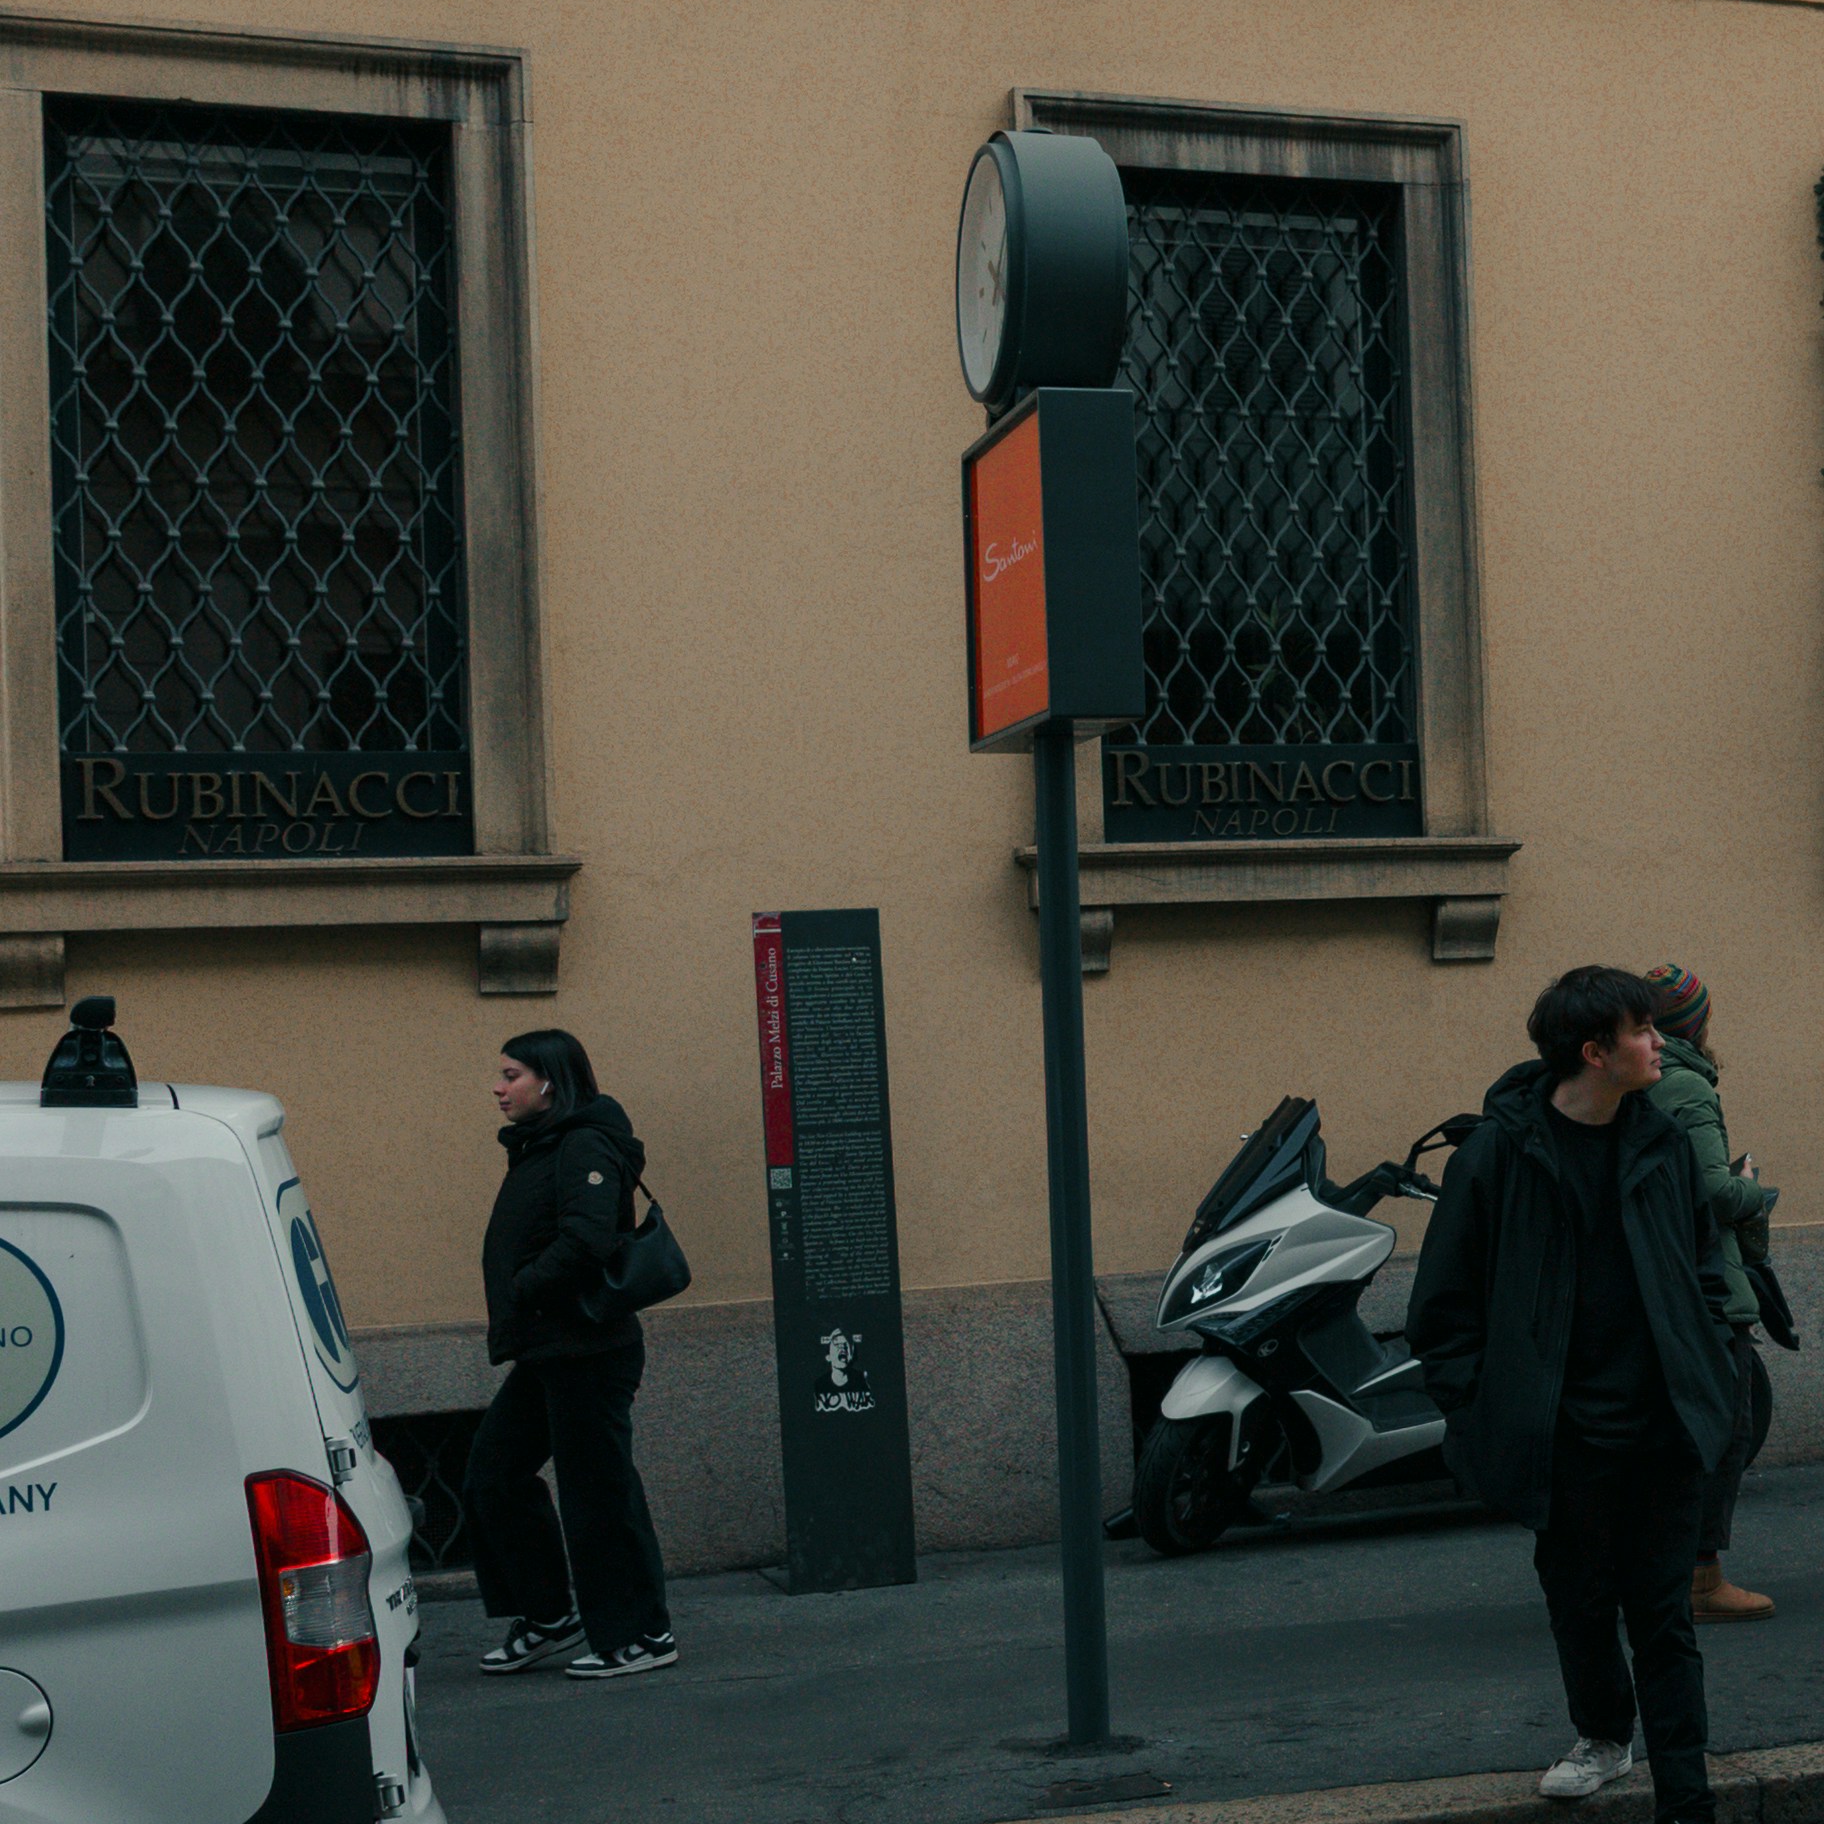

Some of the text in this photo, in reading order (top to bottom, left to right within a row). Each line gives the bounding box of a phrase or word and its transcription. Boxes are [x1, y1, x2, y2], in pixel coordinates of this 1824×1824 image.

[983, 529, 1039, 582] Santoni
[75, 757, 463, 821] RUBINACCI
[1109, 750, 1415, 807] RUBINACCI
[177, 821, 369, 855] NAPOLI
[1190, 808, 1341, 837] NAPOLI
[765, 947, 779, 993] Cusano
[766, 994, 780, 1007] di
[767, 1010, 781, 1044] Melzi
[770, 1045, 784, 1089] Palazzo
